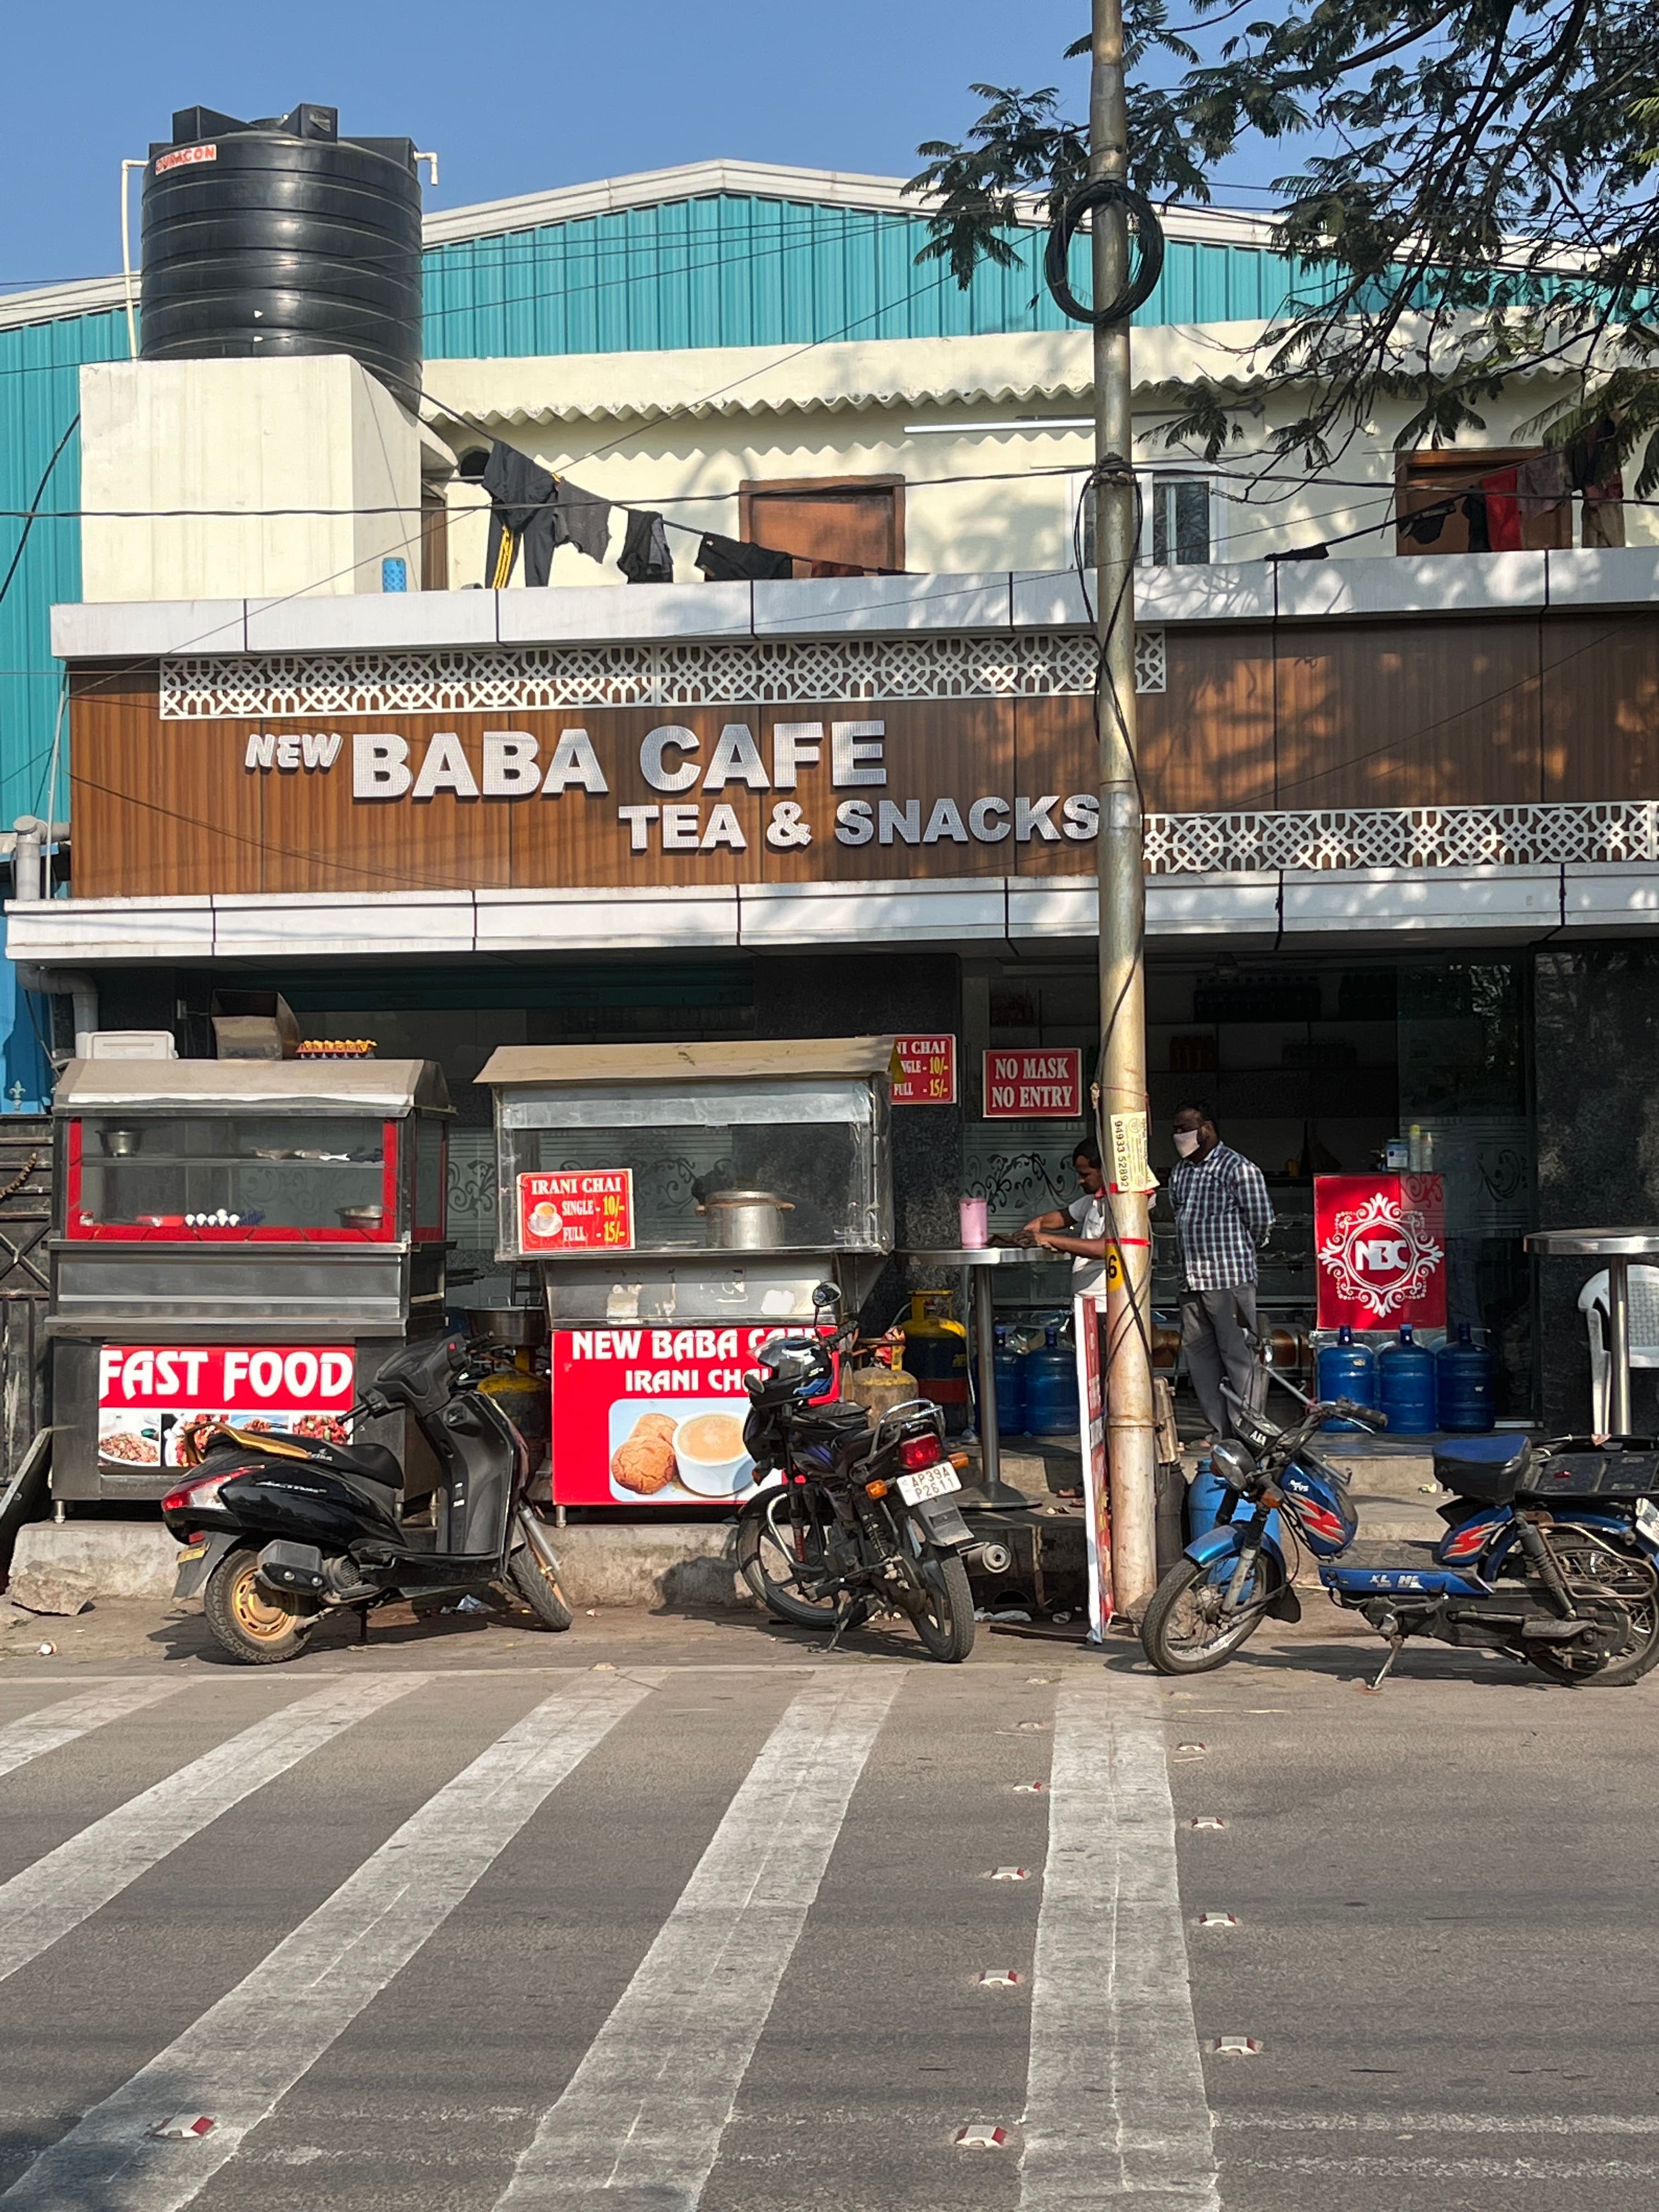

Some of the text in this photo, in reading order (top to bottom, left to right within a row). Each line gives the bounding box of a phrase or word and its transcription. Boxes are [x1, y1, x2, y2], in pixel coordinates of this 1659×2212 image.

[245, 720, 887, 799] NEW BABA CAFE
[618, 794, 1099, 850] TEA & SNACKS
[911, 1041, 946, 1054] CHAI
[929, 1056, 949, 1076] 10/-
[995, 1057, 1069, 1080] NO MASK
[929, 1078, 949, 1098] 15/-
[991, 1085, 1073, 1108] NO ENTRY
[531, 1176, 622, 1195] IRANI CHAI
[561, 1200, 594, 1216] SINGLE
[602, 1195, 625, 1218] 10/-
[562, 1226, 586, 1242] FULL
[603, 1220, 625, 1243] 15/-
[1355, 1240, 1408, 1271] NBC
[572, 1330, 642, 1360] NEW
[651, 1329, 738, 1362] BABA
[99, 1350, 353, 1402] FAST FOOD
[625, 1369, 699, 1393] IRANI
[911, 1466, 950, 1487] AP39A
[915, 1477, 955, 1500] P2611
